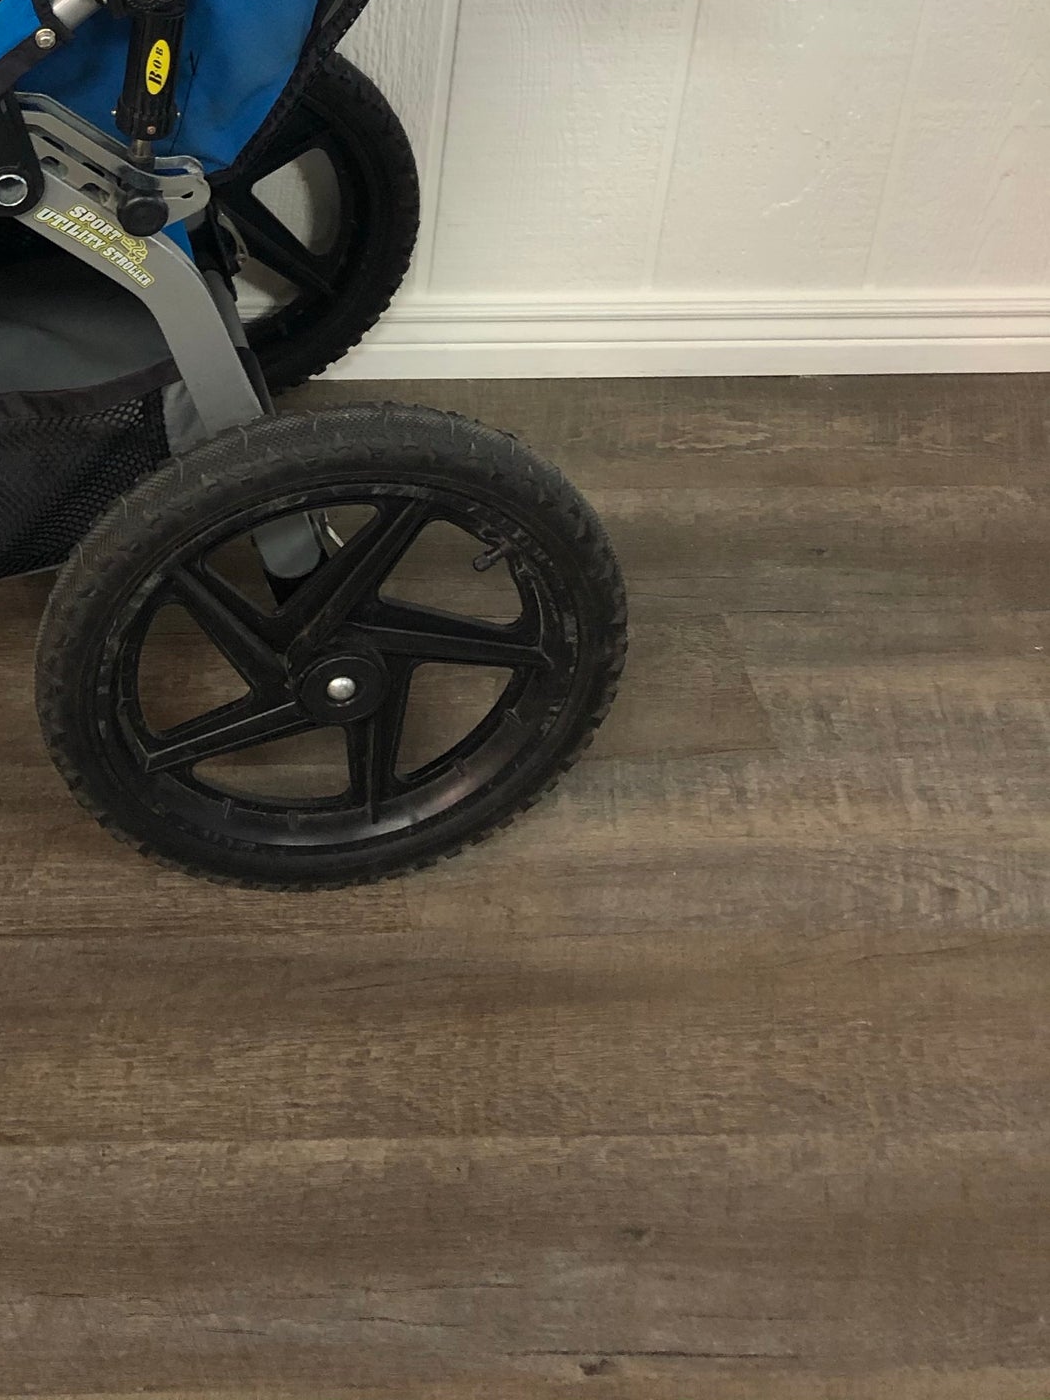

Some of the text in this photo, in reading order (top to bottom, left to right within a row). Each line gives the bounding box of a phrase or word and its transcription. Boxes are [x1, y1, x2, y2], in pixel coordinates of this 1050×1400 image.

[35, 207, 152, 286] UTILITY STROLLER
[69, 205, 123, 241] SPORT
